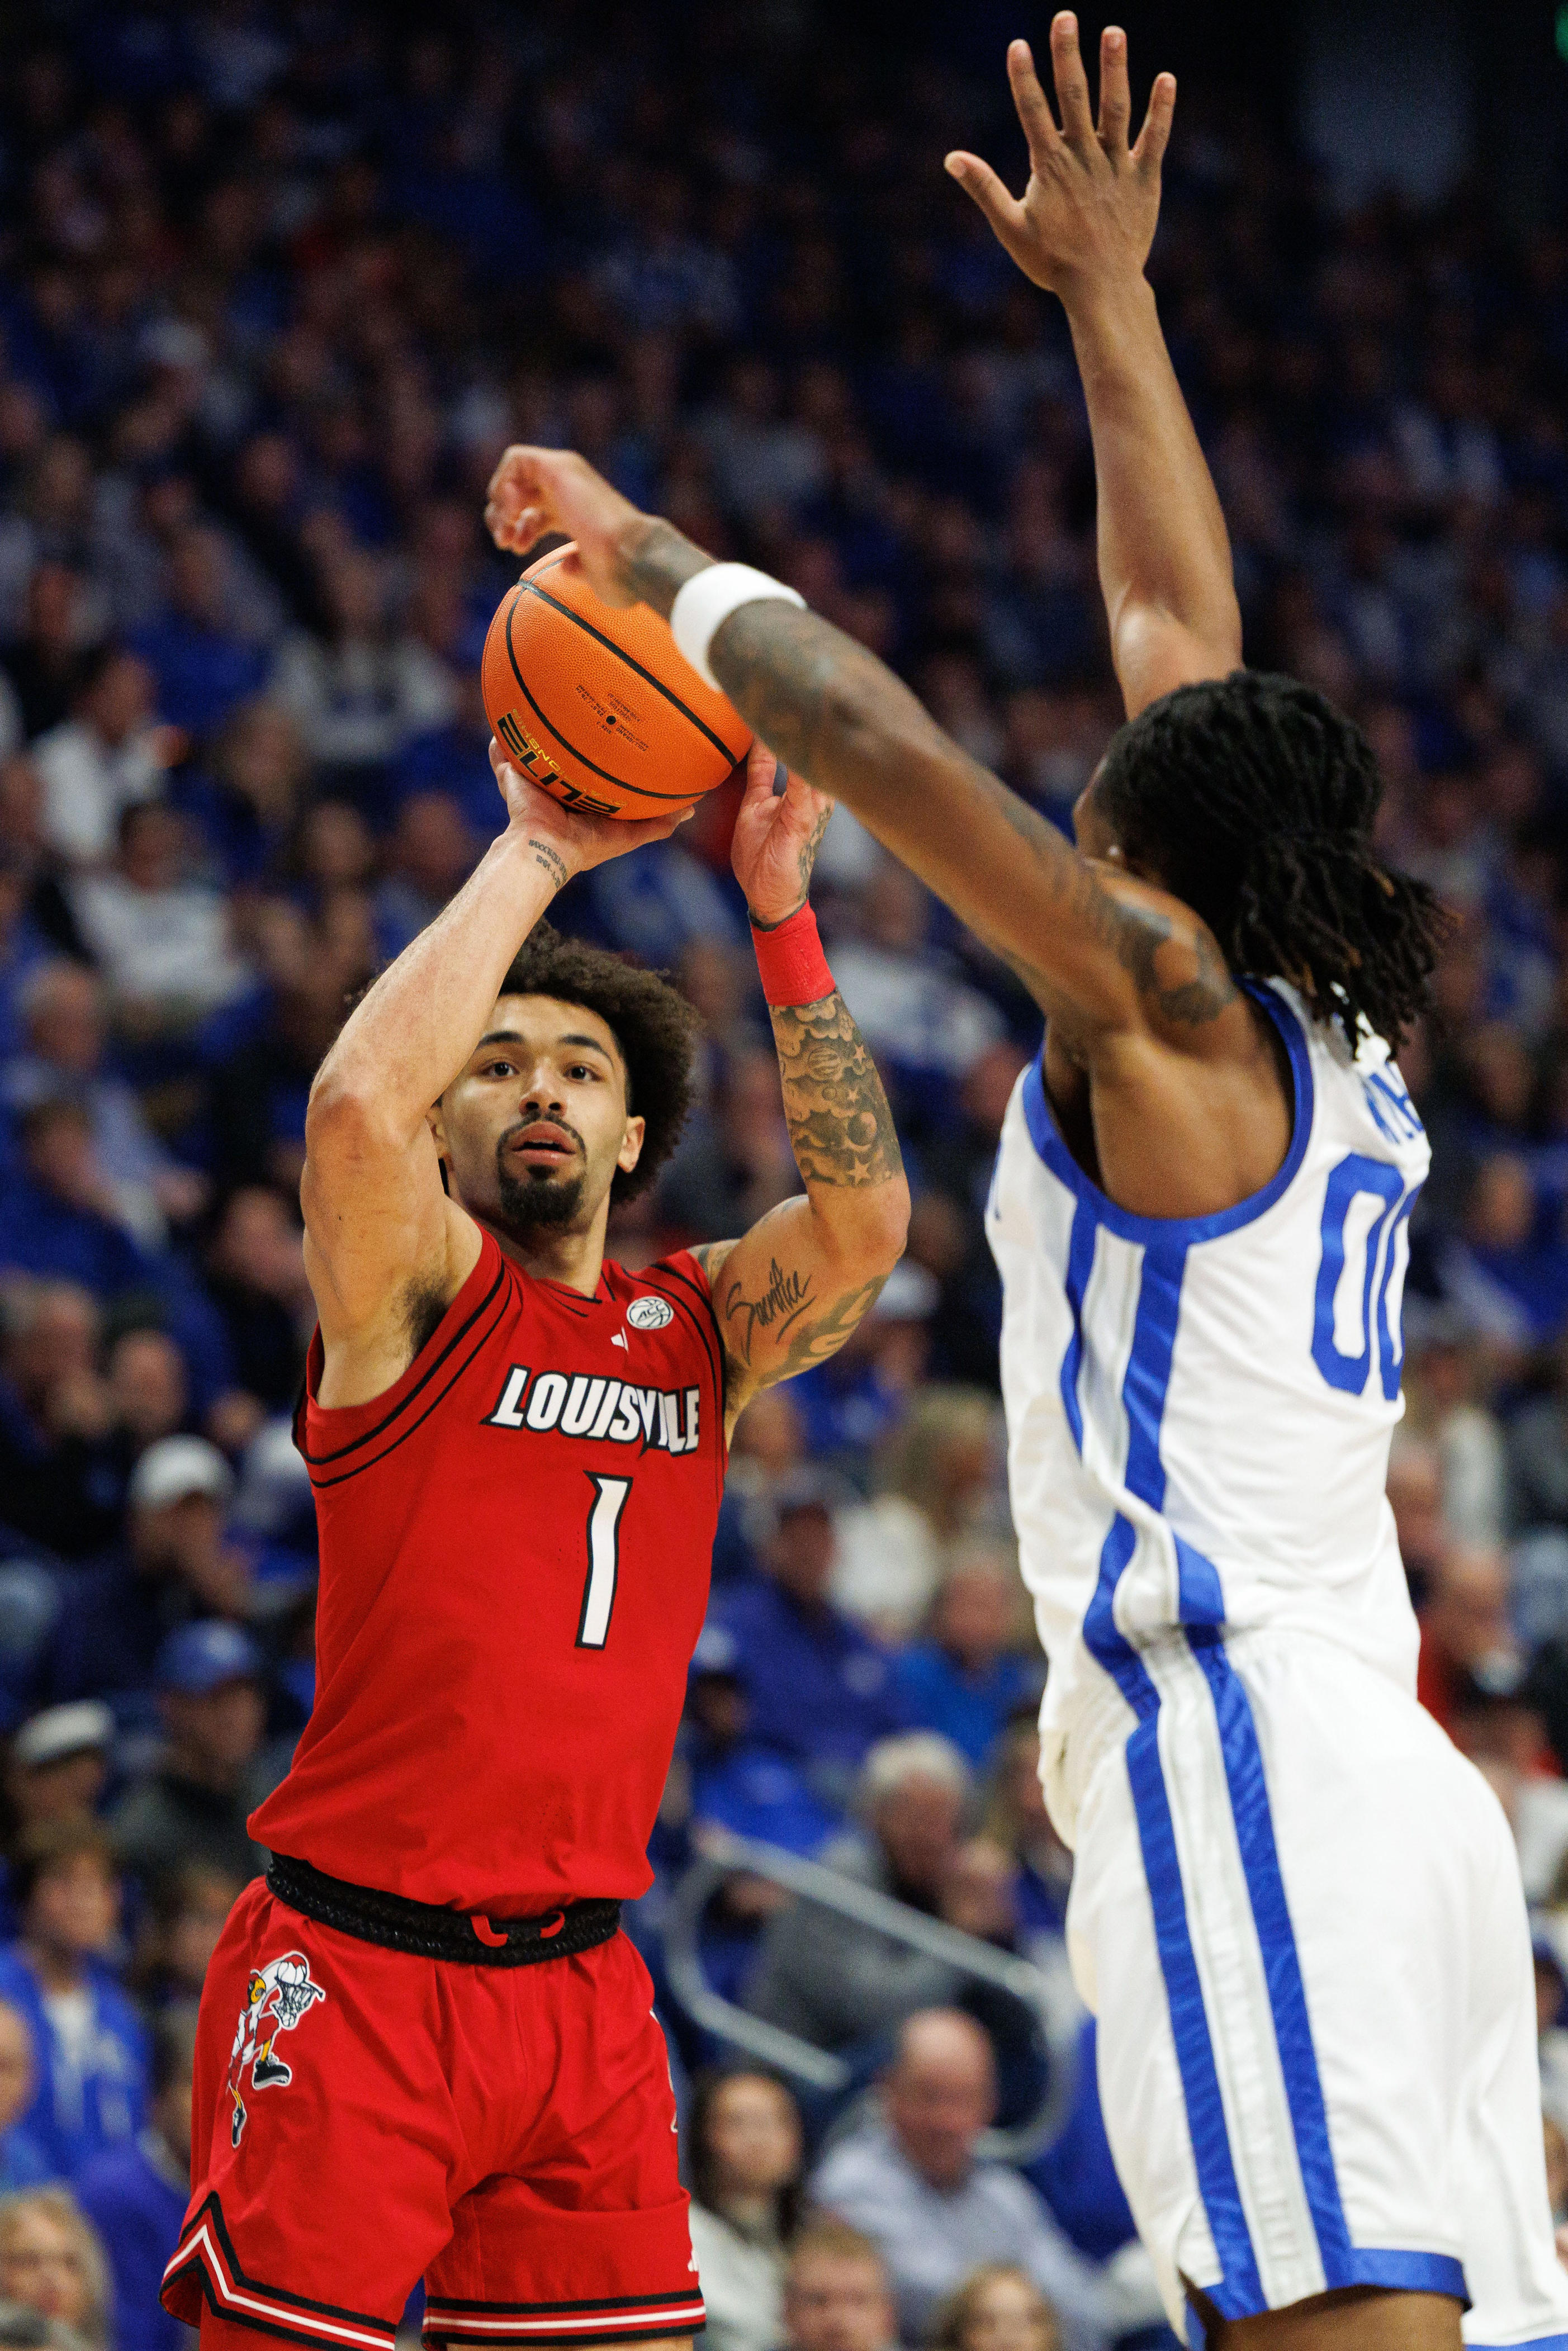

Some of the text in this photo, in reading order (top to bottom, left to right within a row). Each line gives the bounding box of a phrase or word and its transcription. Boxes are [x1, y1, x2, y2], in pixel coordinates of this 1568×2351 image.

[497, 712, 622, 816] ELITE
[636, 1303, 666, 1323] ACC
[479, 1363, 700, 1459] LOUISVILE
[575, 1470, 633, 1651] 1
